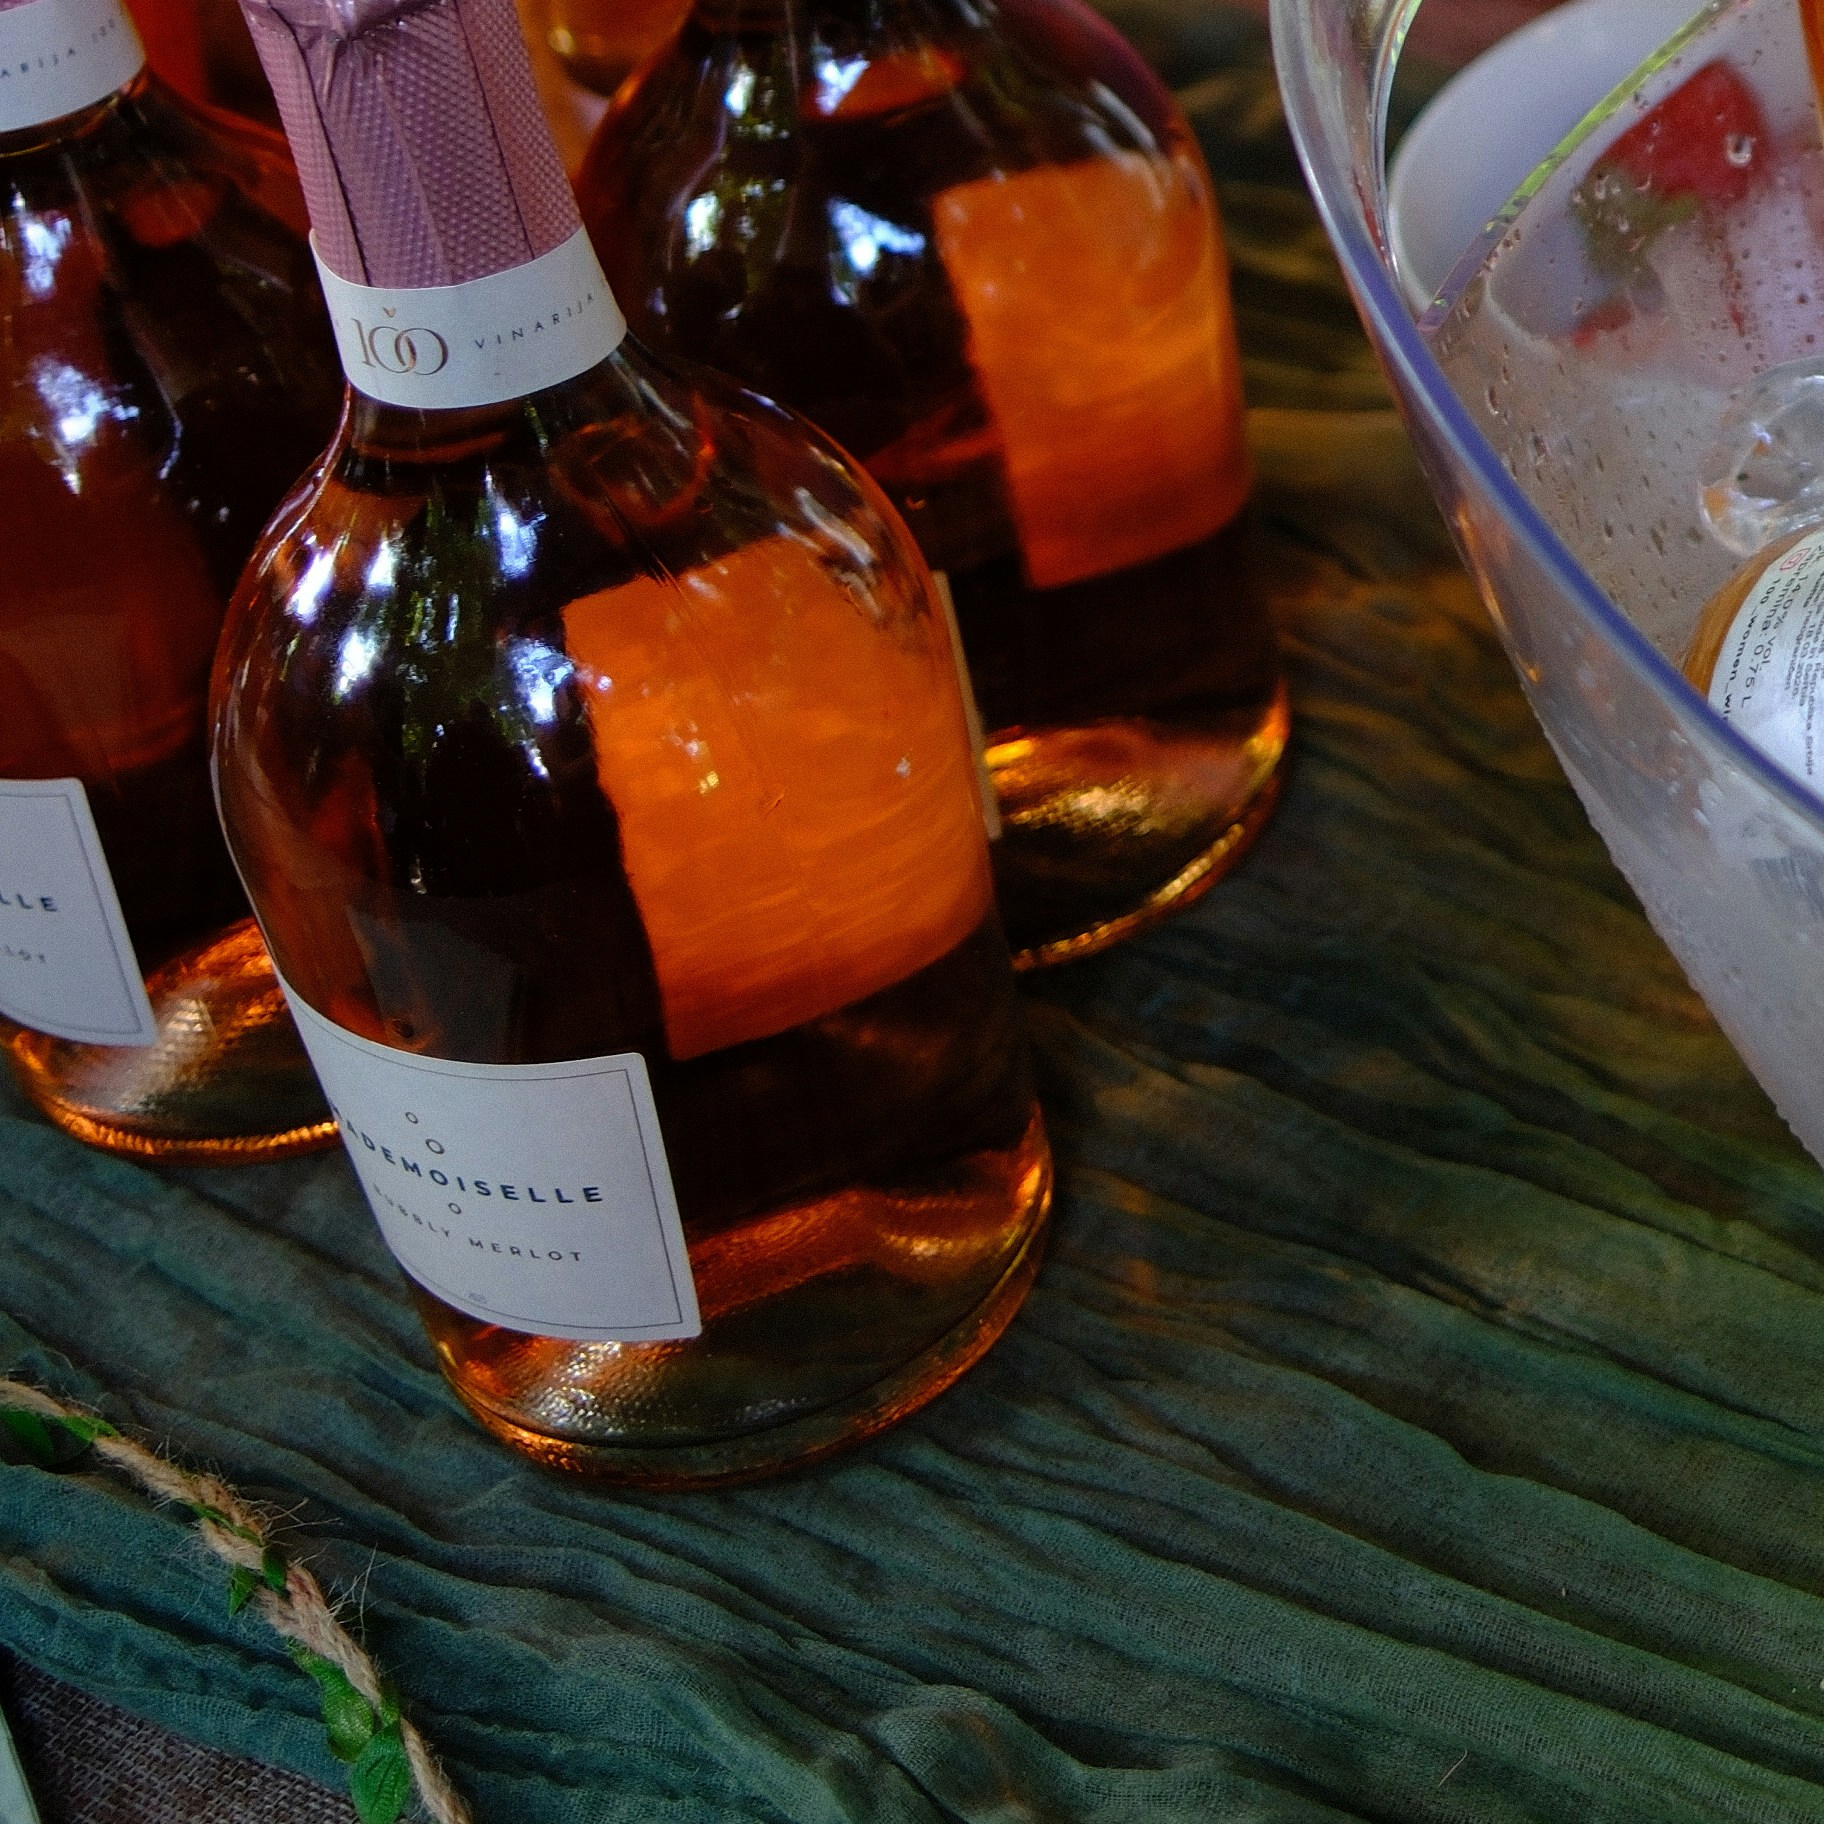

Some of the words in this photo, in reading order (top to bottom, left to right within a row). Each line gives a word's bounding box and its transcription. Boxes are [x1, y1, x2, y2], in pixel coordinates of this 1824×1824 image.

[350, 306, 449, 376] 100
[475, 293, 594, 350] VINARIJA
[1718, 577, 1782, 722] 100_women_wi
[468, 1236, 581, 1262] MERLOT
